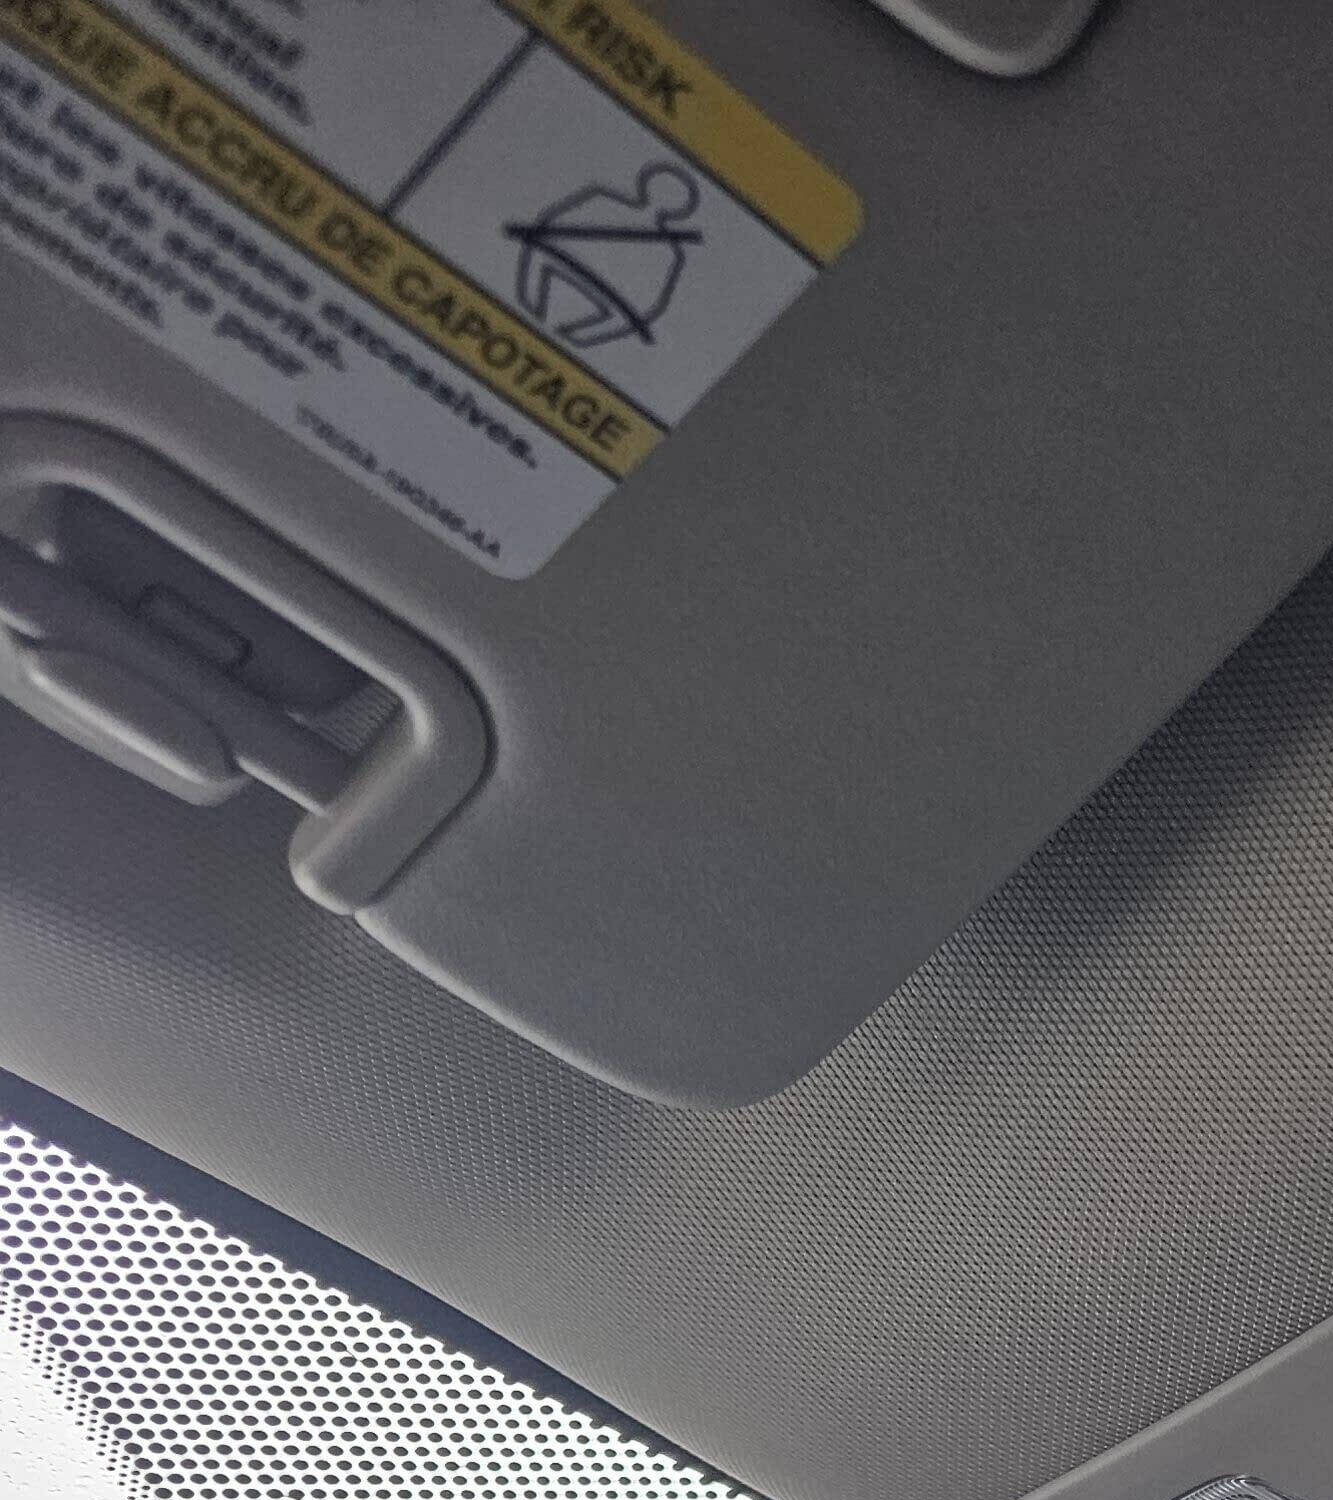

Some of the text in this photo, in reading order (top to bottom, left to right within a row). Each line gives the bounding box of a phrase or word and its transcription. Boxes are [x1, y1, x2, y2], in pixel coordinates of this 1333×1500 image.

[134, 82, 318, 220] ACCRU
[316, 210, 396, 276] DE
[390, 263, 632, 452] CAPOTAGE
[319, 300, 539, 470] excessives.
